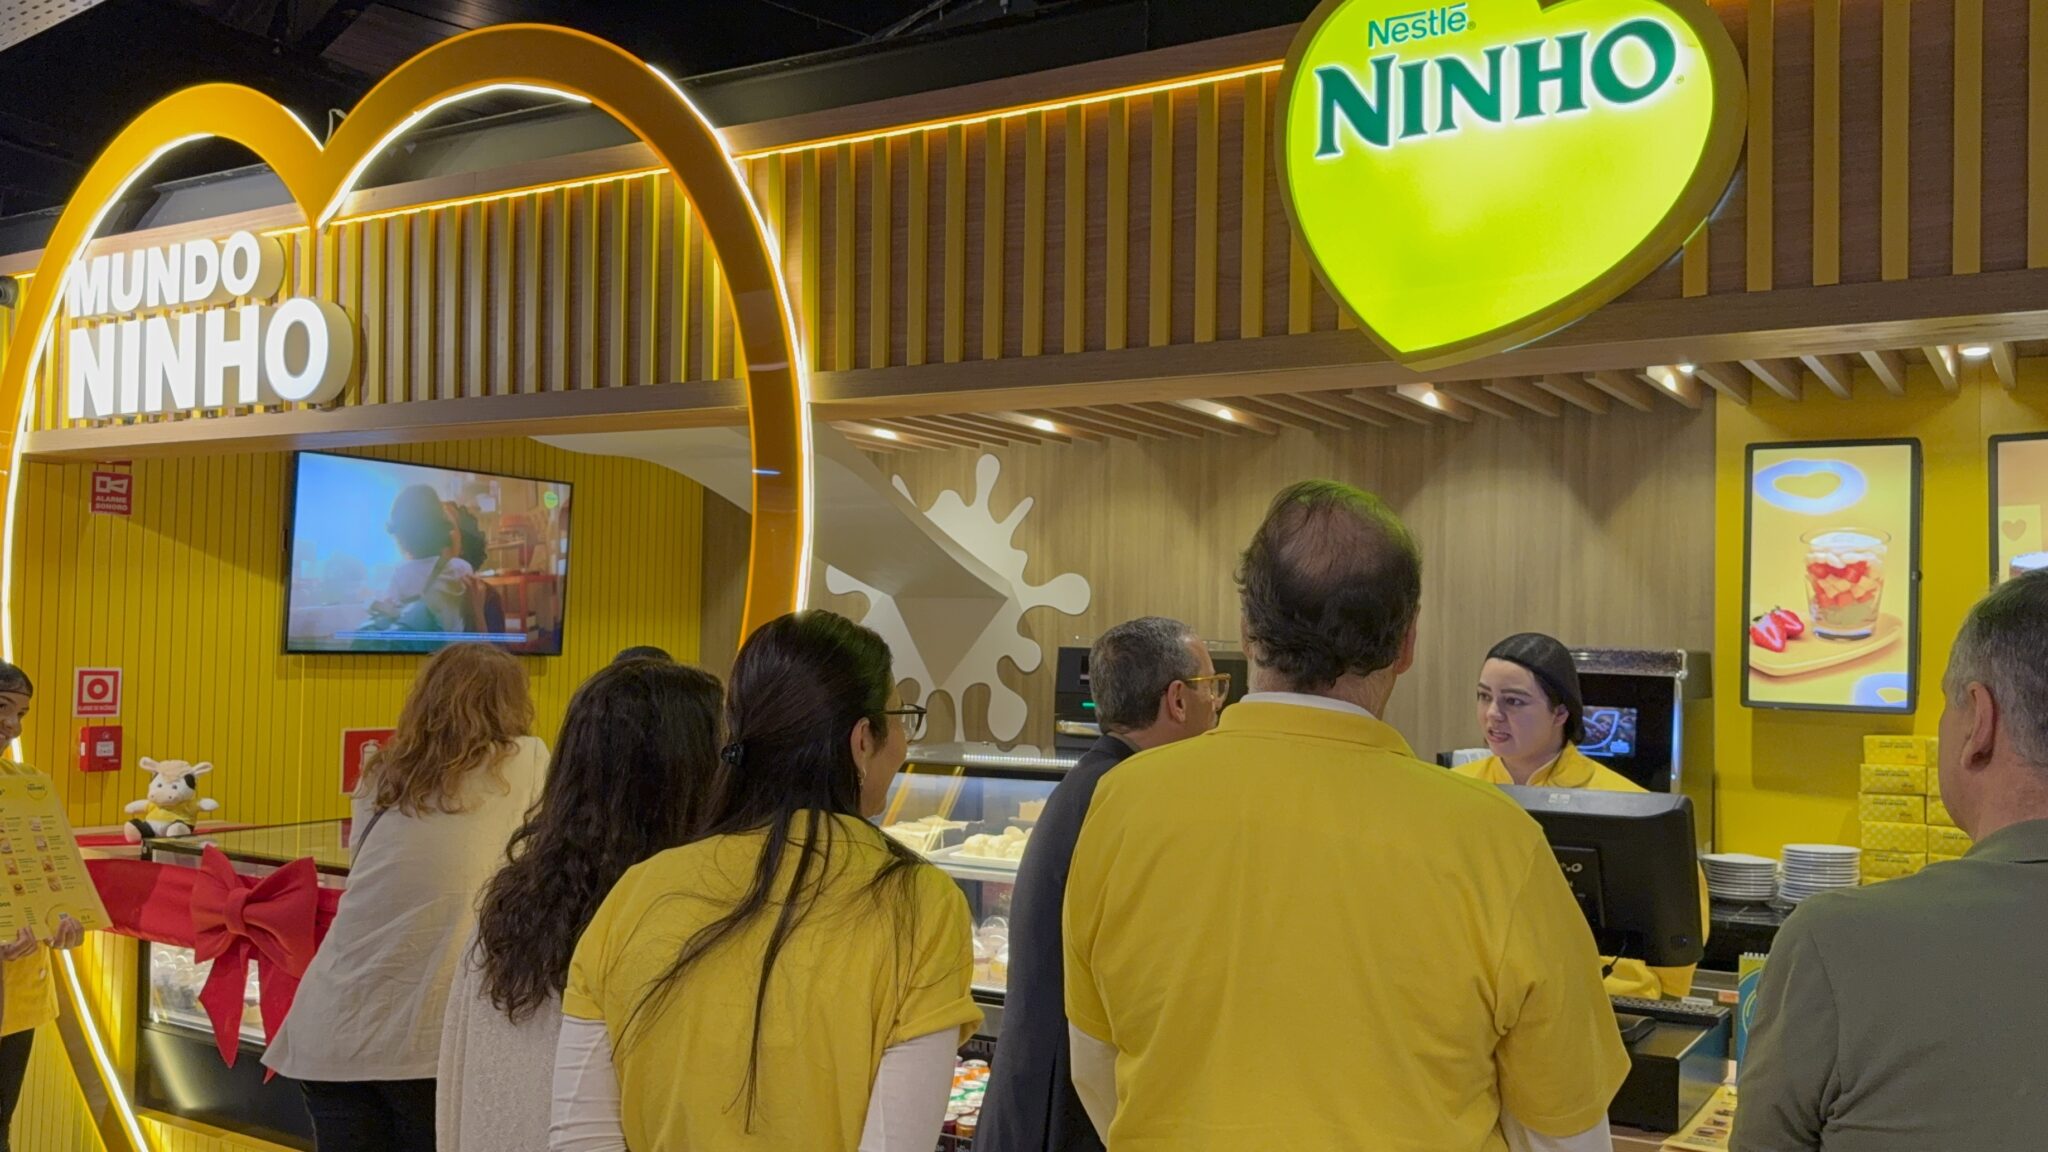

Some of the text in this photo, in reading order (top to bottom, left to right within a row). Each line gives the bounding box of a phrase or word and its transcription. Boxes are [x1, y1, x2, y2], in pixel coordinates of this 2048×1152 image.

[1314, 18, 1677, 157] NINHO
[66, 230, 261, 318] MUNDO
[68, 297, 329, 419] NINHO
[95, 496, 127, 504] ALARME
[95, 503, 128, 511] SONORO
